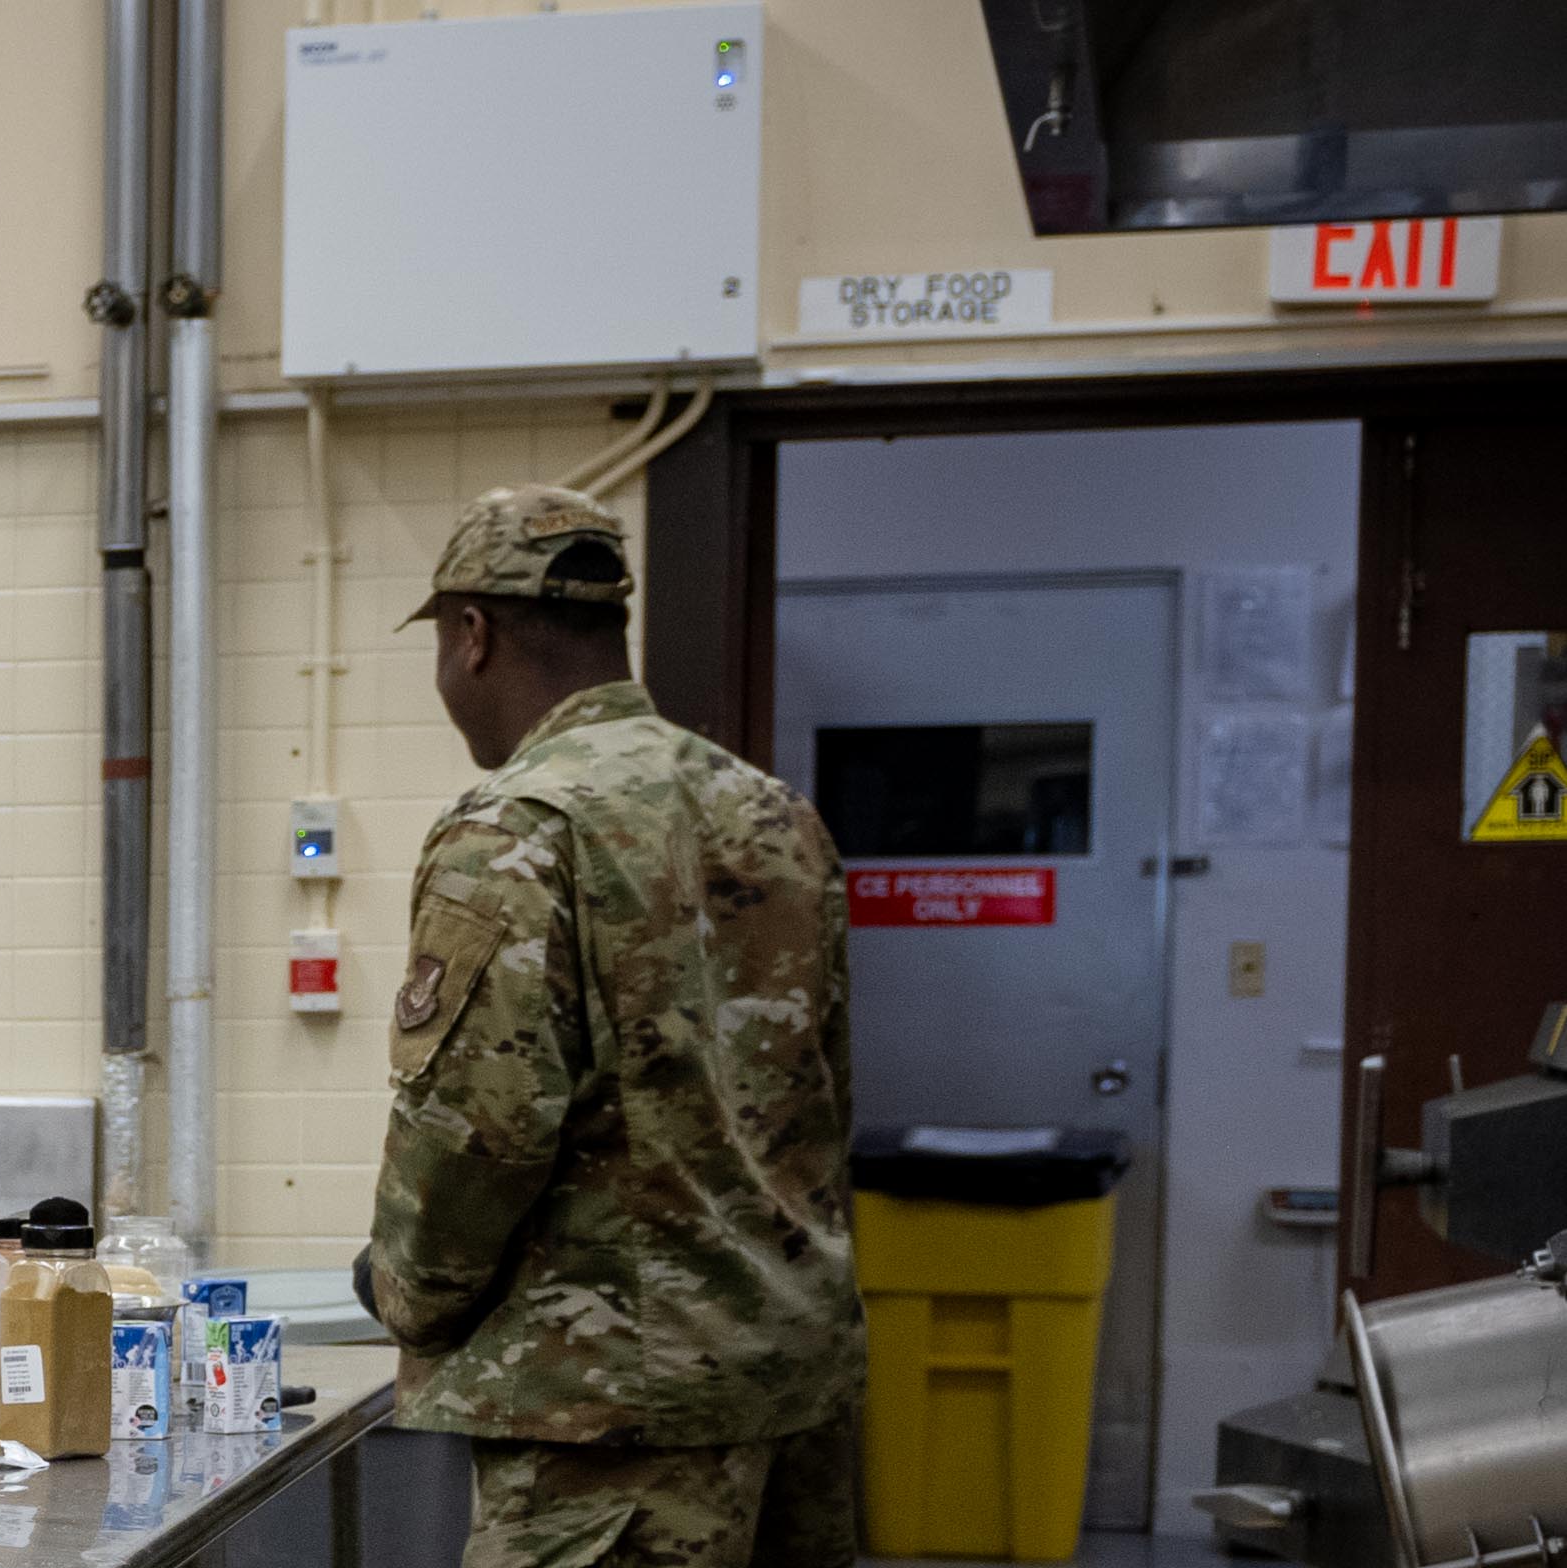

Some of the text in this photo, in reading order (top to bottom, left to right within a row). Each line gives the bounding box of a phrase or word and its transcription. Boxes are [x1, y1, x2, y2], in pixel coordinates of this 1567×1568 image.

[839, 271, 1012, 305] DRY FOOD
[850, 300, 998, 328] STORAGE
